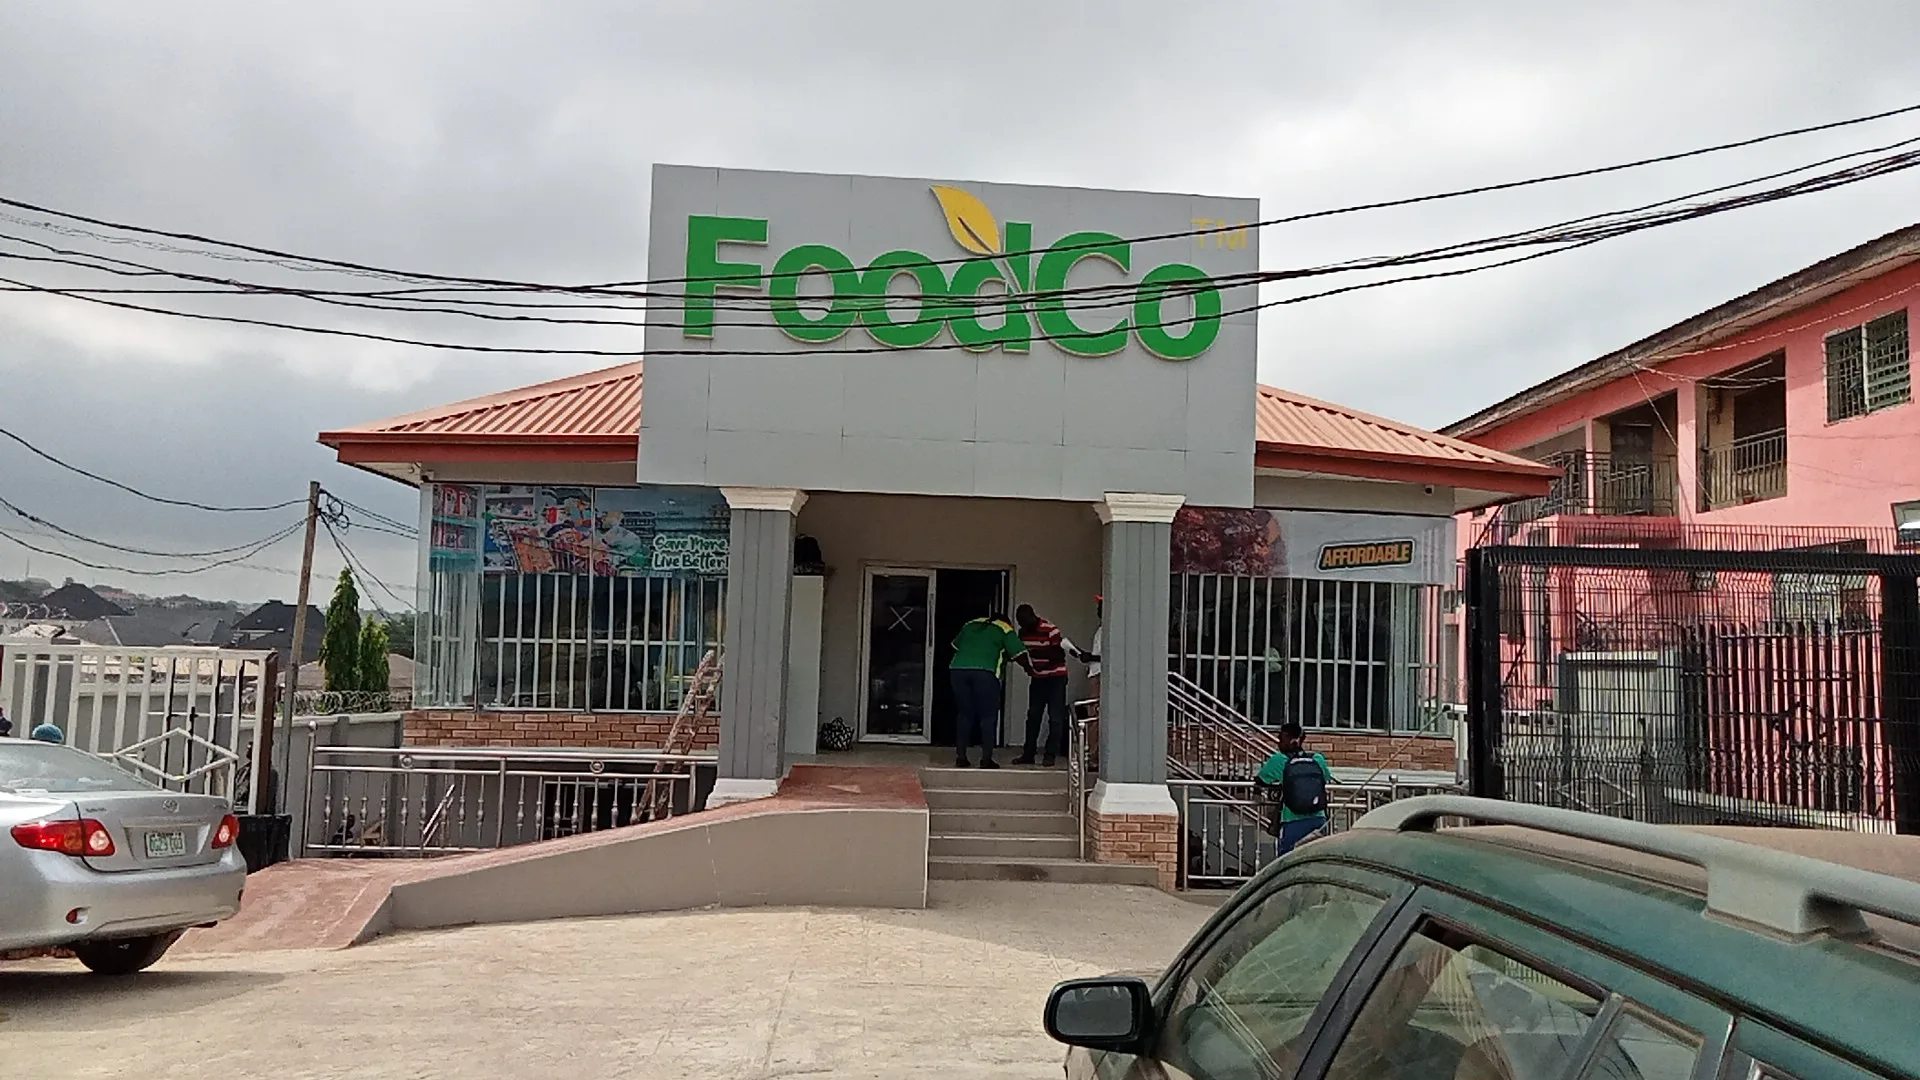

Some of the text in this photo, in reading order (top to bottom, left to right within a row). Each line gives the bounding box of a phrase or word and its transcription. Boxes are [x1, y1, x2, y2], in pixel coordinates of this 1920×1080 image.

[683, 214, 1222, 360] FoodCo
[654, 535, 688, 550] Save
[654, 552, 680, 567] Live
[1322, 543, 1410, 567] AFFORDABLE
